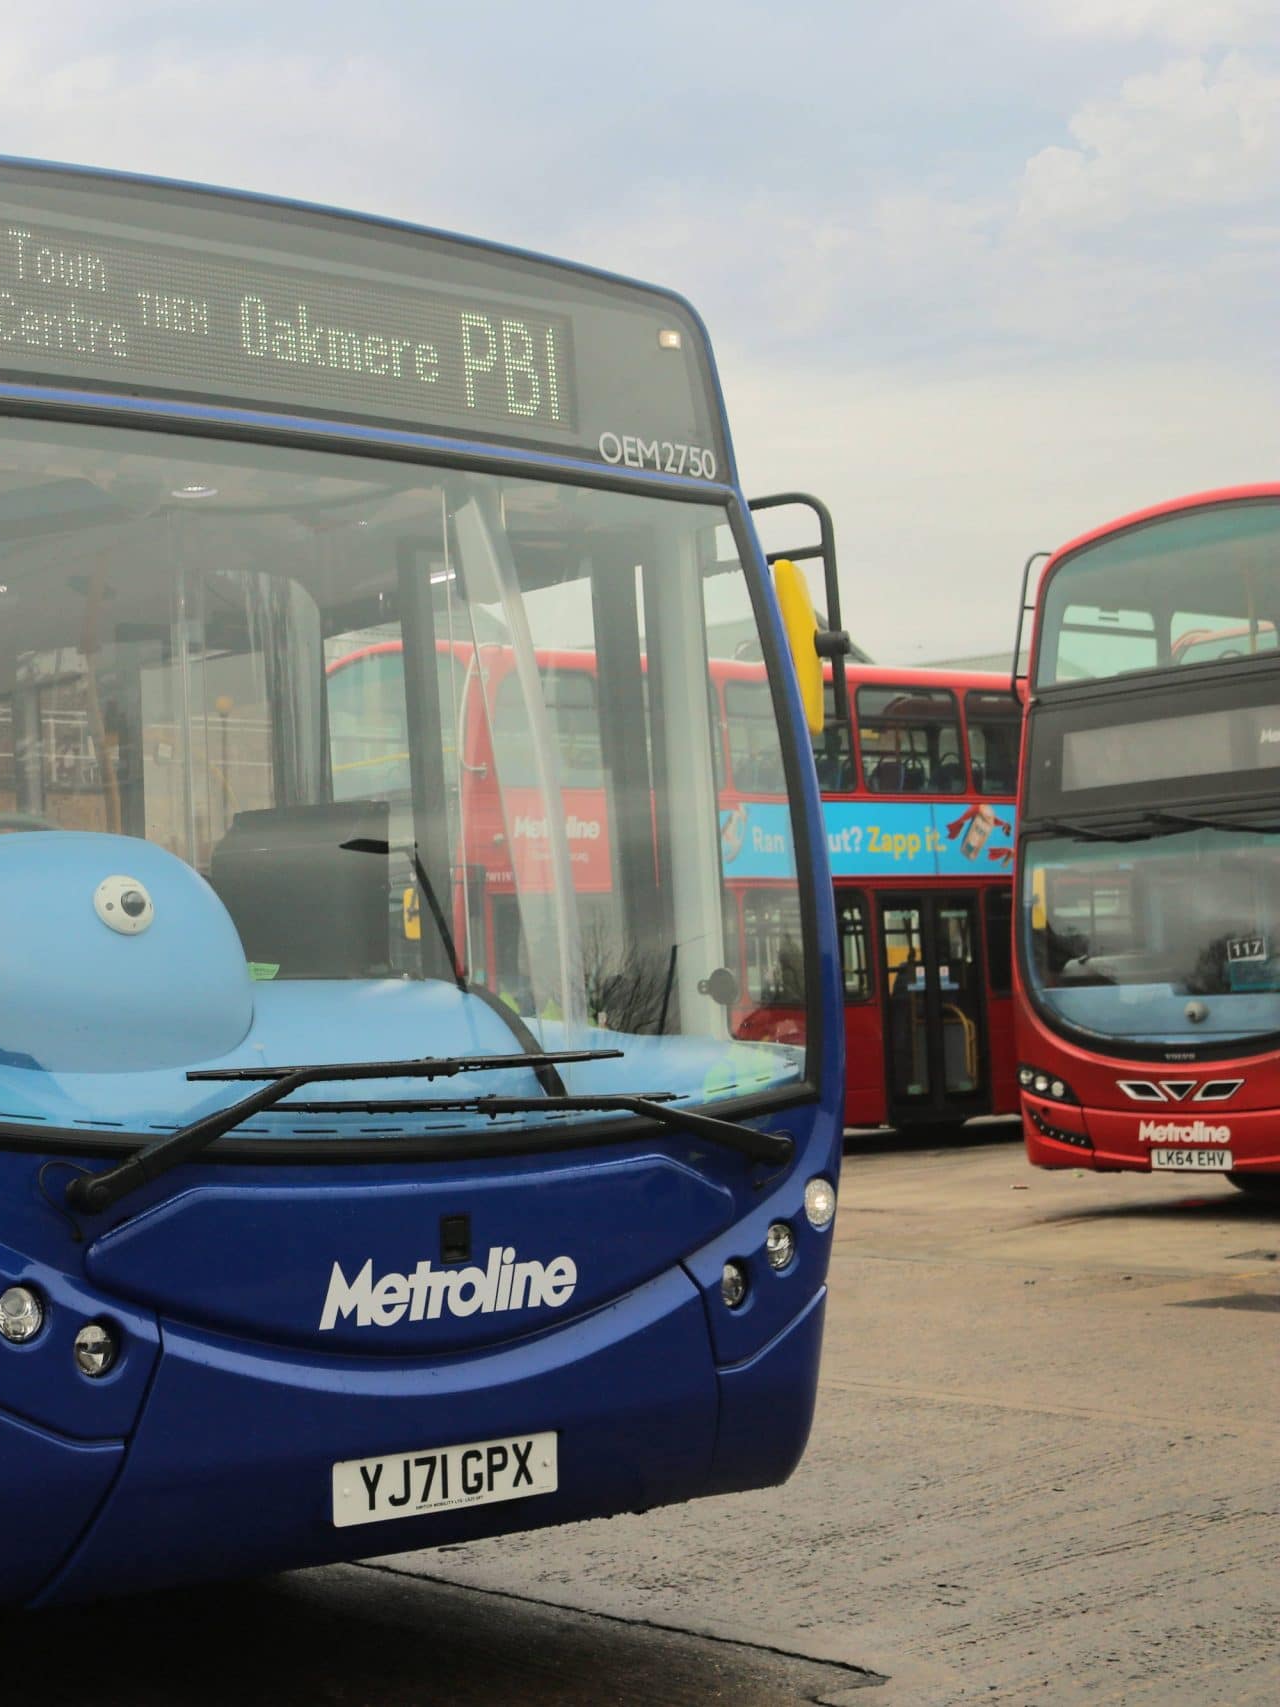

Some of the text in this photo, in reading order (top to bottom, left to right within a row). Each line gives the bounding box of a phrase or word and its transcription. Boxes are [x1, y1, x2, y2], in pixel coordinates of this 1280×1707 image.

[7, 229, 106, 292] Town
[136, 291, 209, 335] THEN
[240, 296, 440, 383] Oakmere
[599, 431, 716, 480] OEM2750
[752, 826, 947, 859] Ran ut? Zapp it.
[1232, 940, 1262, 957] 117
[1138, 1120, 1231, 1143] Metroline
[1157, 1151, 1226, 1167] LK64 EHV
[319, 1246, 578, 1331] Metroline
[360, 1441, 534, 1511] YJ71 GPX
